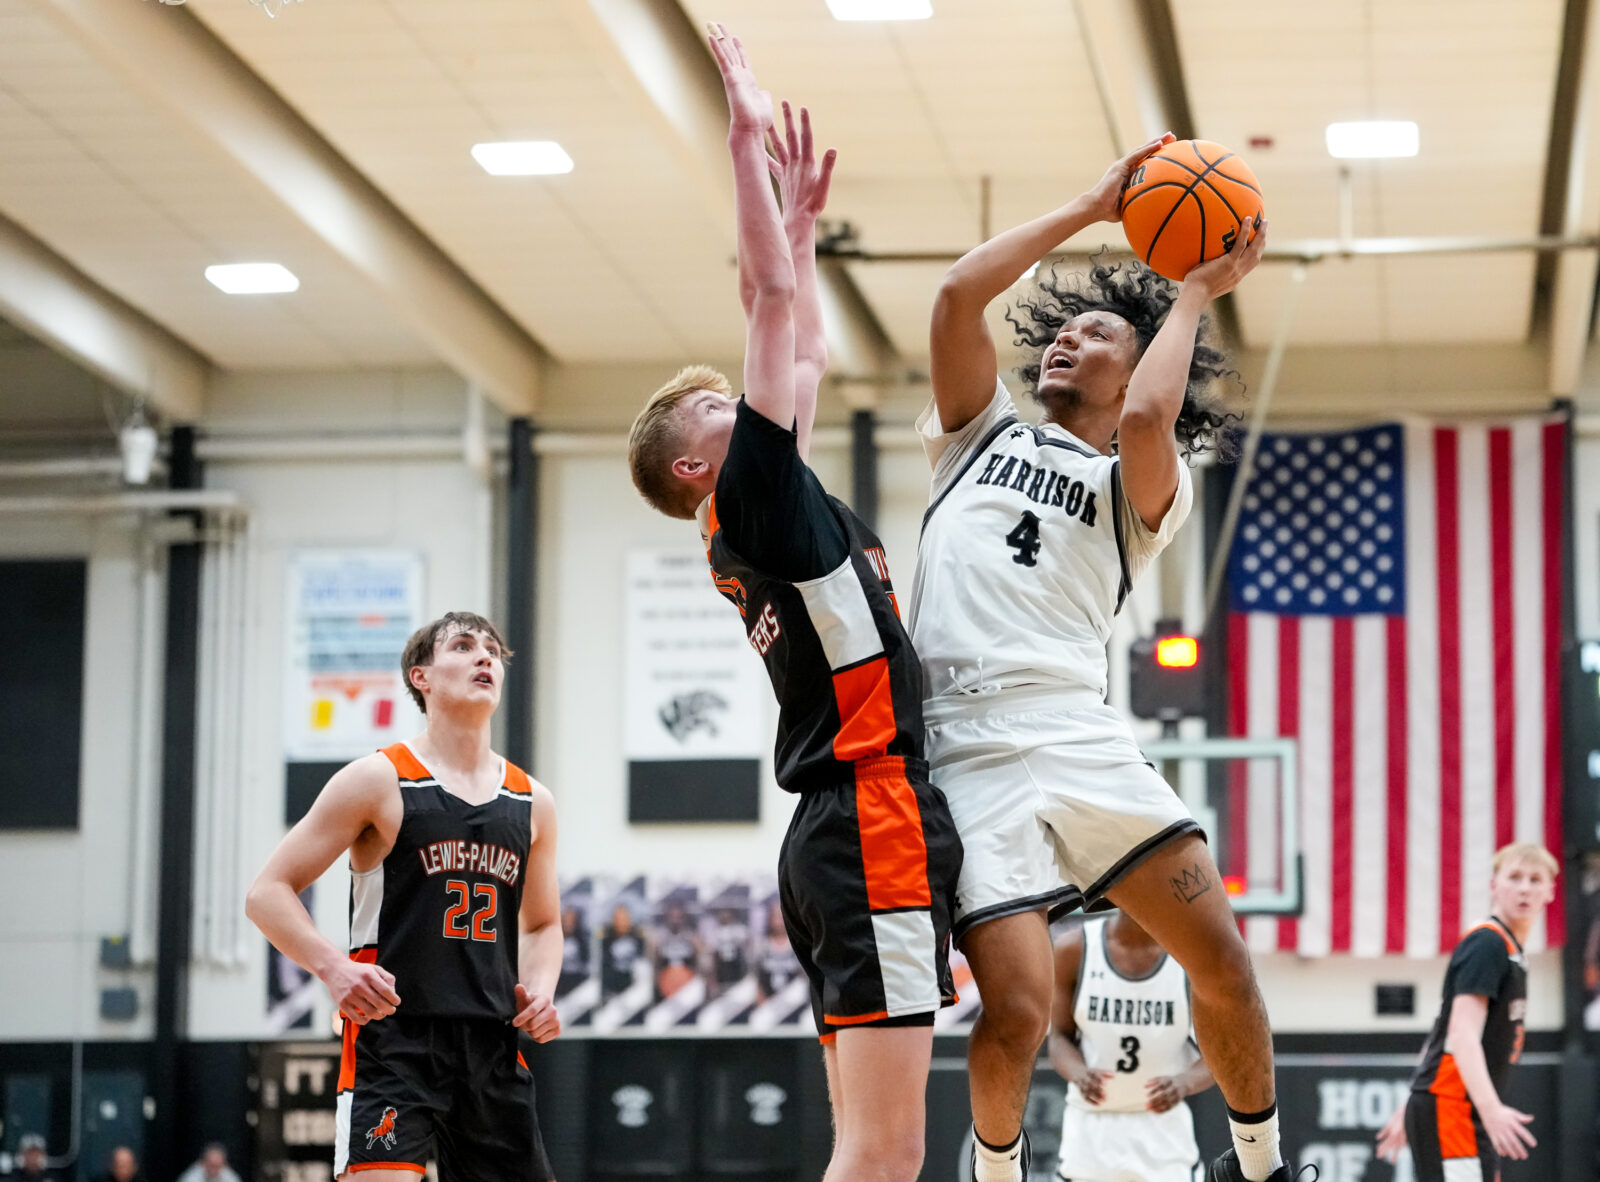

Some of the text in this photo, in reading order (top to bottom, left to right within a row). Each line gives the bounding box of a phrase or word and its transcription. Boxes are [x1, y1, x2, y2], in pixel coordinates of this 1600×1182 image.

[976, 453, 1097, 528] HARRISON
[1005, 510, 1042, 568] 4
[419, 840, 520, 887] LEWIS-PALMER
[443, 879, 498, 942] 22
[1087, 995, 1175, 1026] HARRISON
[1116, 1035, 1140, 1074] 3
